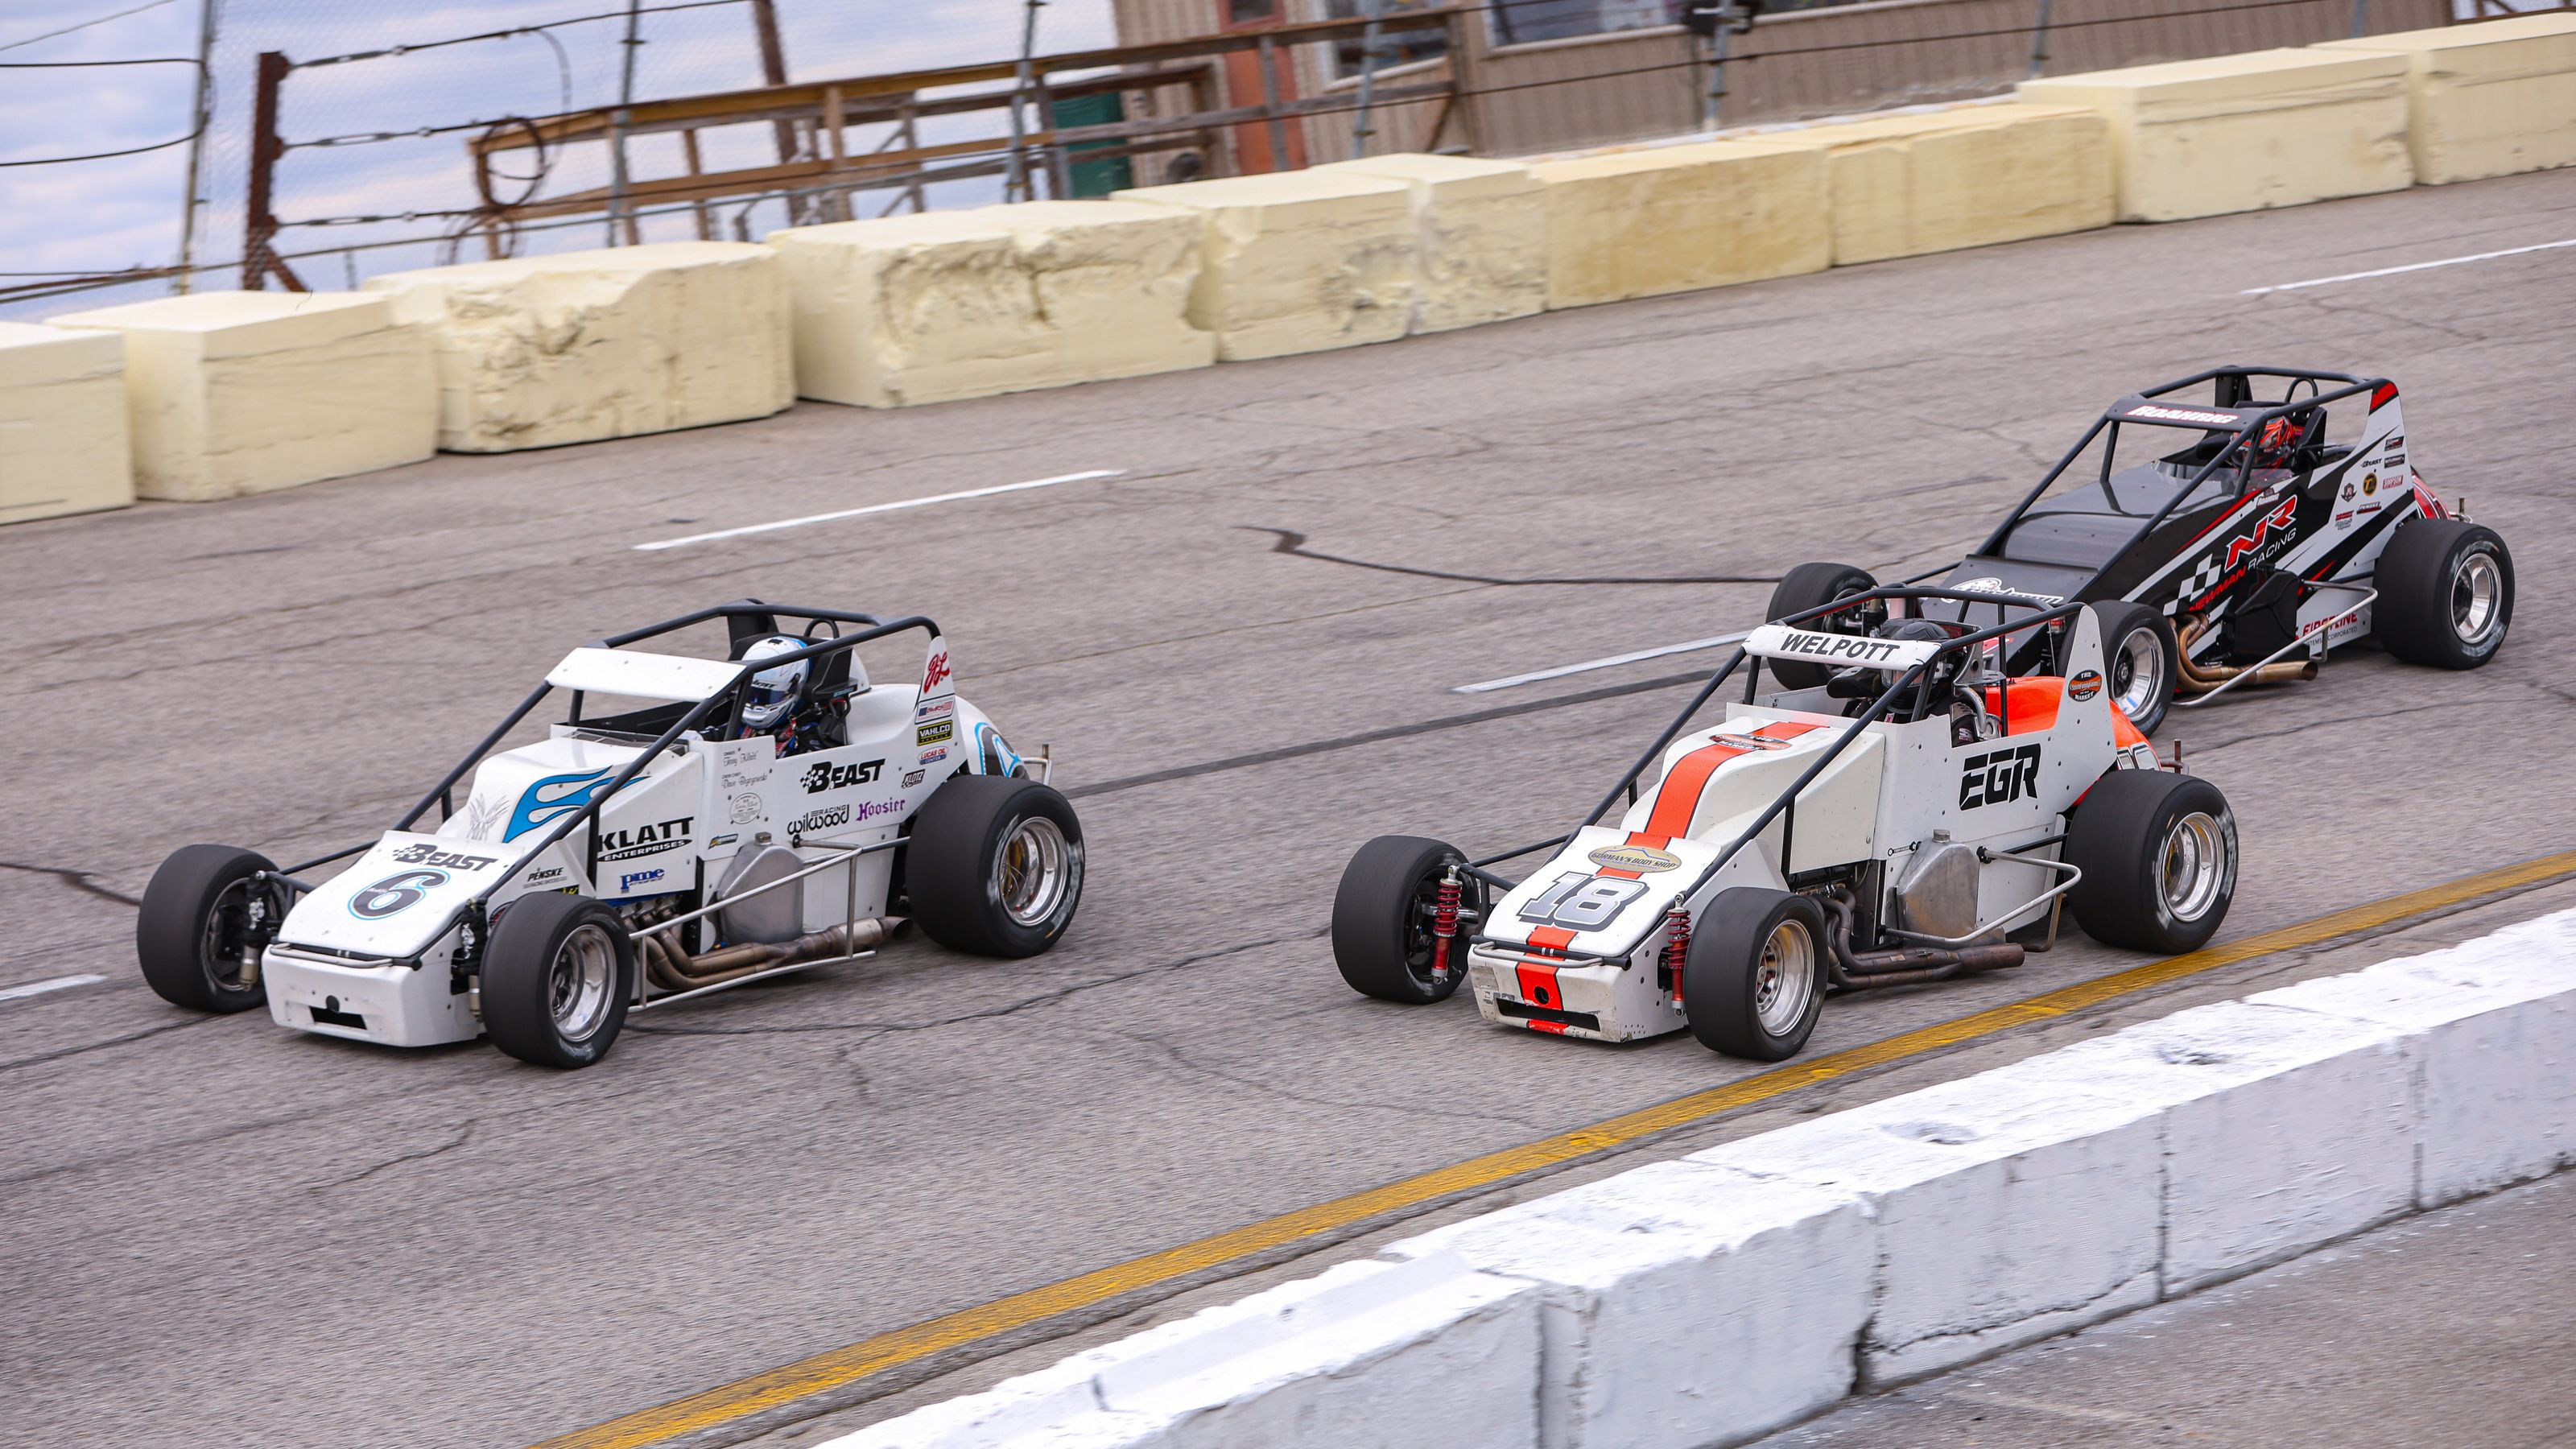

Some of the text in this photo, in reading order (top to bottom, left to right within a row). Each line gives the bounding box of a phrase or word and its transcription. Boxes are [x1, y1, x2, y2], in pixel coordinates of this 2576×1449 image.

[2360, 458, 2383, 468] BEAST
[2190, 528, 2297, 611] NEWMAN RACING
[1780, 634, 1900, 661] WELPOTT
[2074, 691, 2094, 701] MARKET
[919, 724, 951, 738] VAHLCO
[920, 747, 947, 760] LUCAS OIL
[801, 758, 886, 794] BEAST
[1959, 743, 2041, 811] EGR
[787, 804, 850, 835] wilwood
[819, 804, 846, 815] RACING
[856, 797, 906, 821] Hoosier
[598, 816, 694, 852] KLATT
[393, 844, 498, 871] BEAST
[605, 840, 686, 861] ENTERPRISES
[1591, 852, 1632, 862] GORMAN'S
[1632, 857, 1653, 865] BODY
[1653, 861, 1675, 869] SHOP
[527, 867, 564, 882] PENSKE
[621, 869, 666, 890] pme
[348, 869, 451, 920] 6
[1517, 871, 1650, 932] 18
